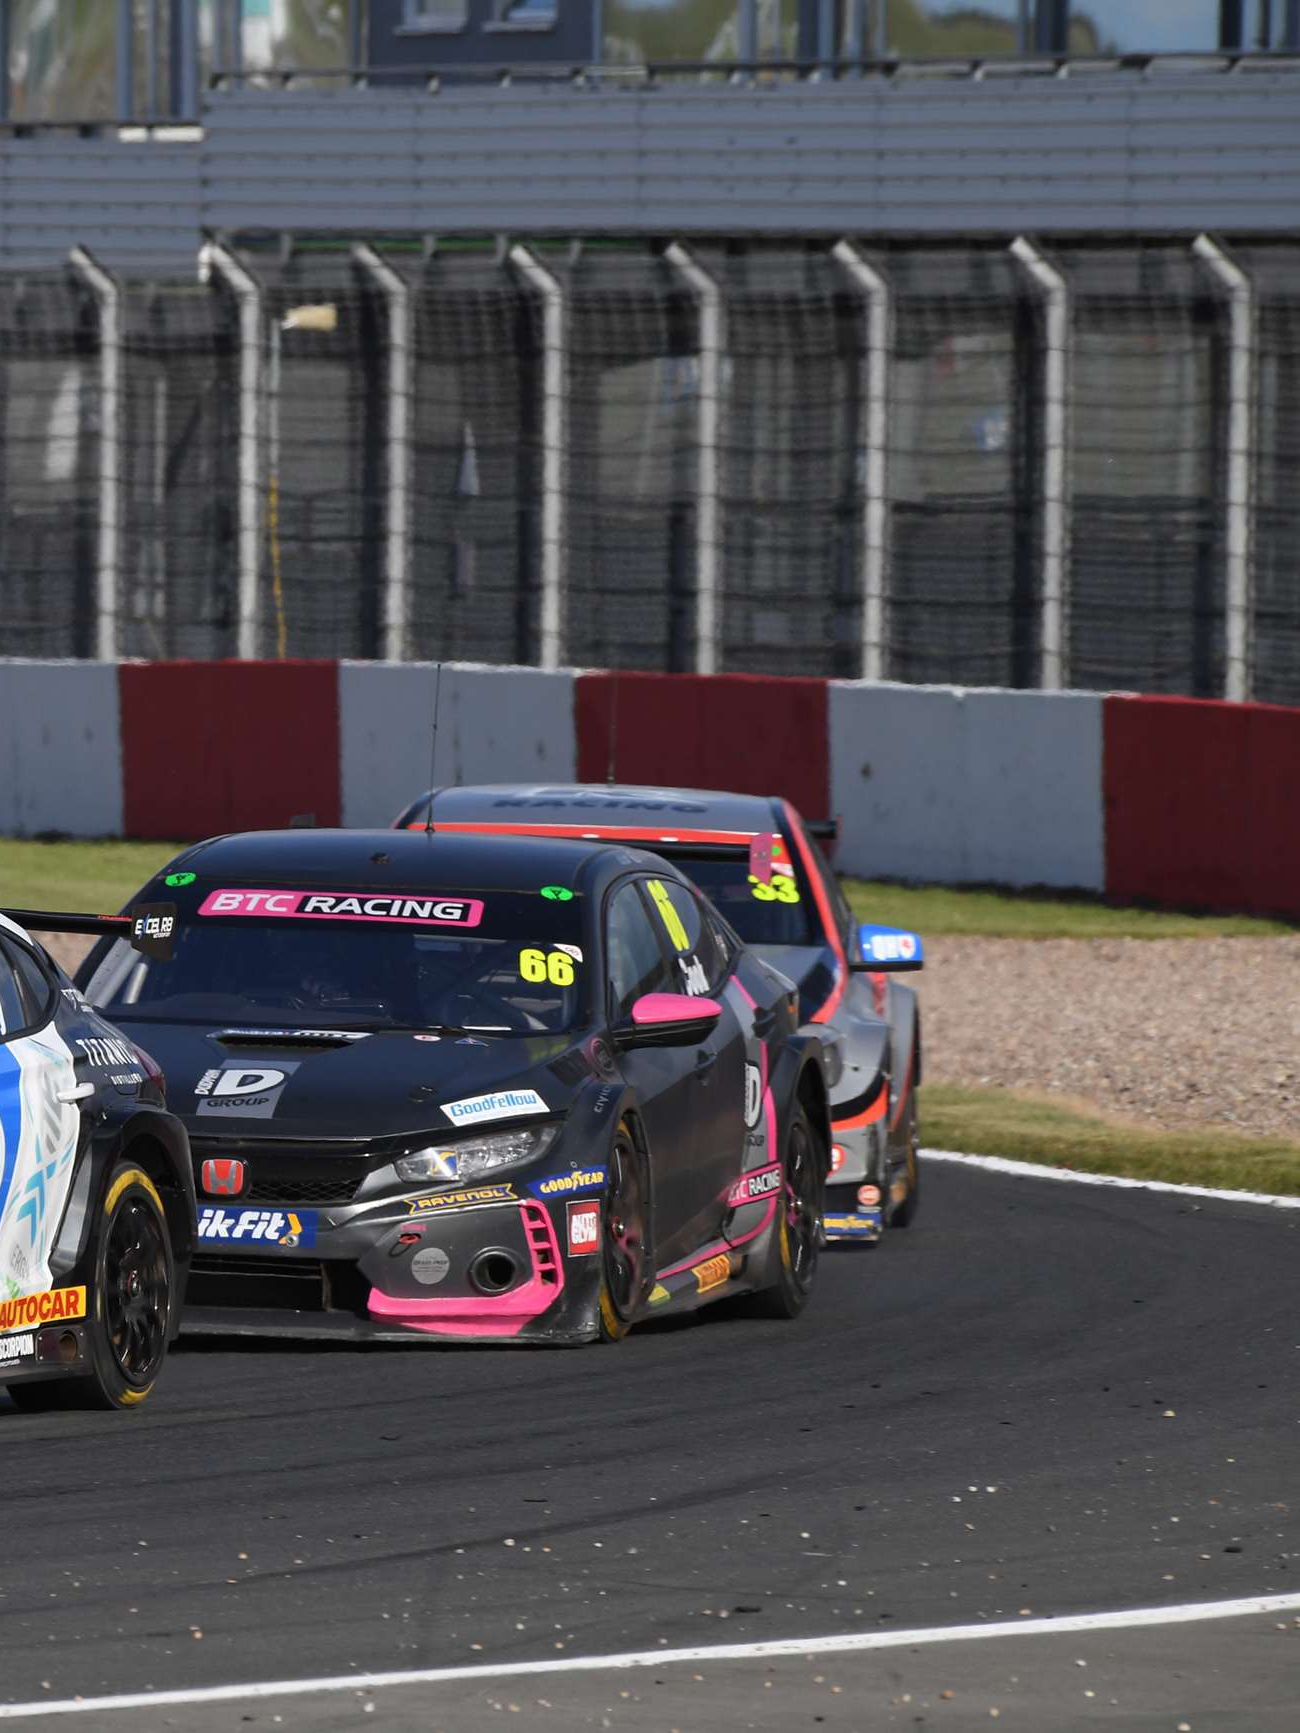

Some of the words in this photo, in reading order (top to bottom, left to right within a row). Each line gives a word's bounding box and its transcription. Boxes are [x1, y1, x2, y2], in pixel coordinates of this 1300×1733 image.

[211, 891, 294, 912] BTC
[303, 896, 465, 921] RACING
[519, 948, 575, 986] 66
[207, 1097, 269, 1109] GROUP
[539, 1170, 605, 1195] GOODYEAR
[417, 1189, 506, 1209] RAVENOL
